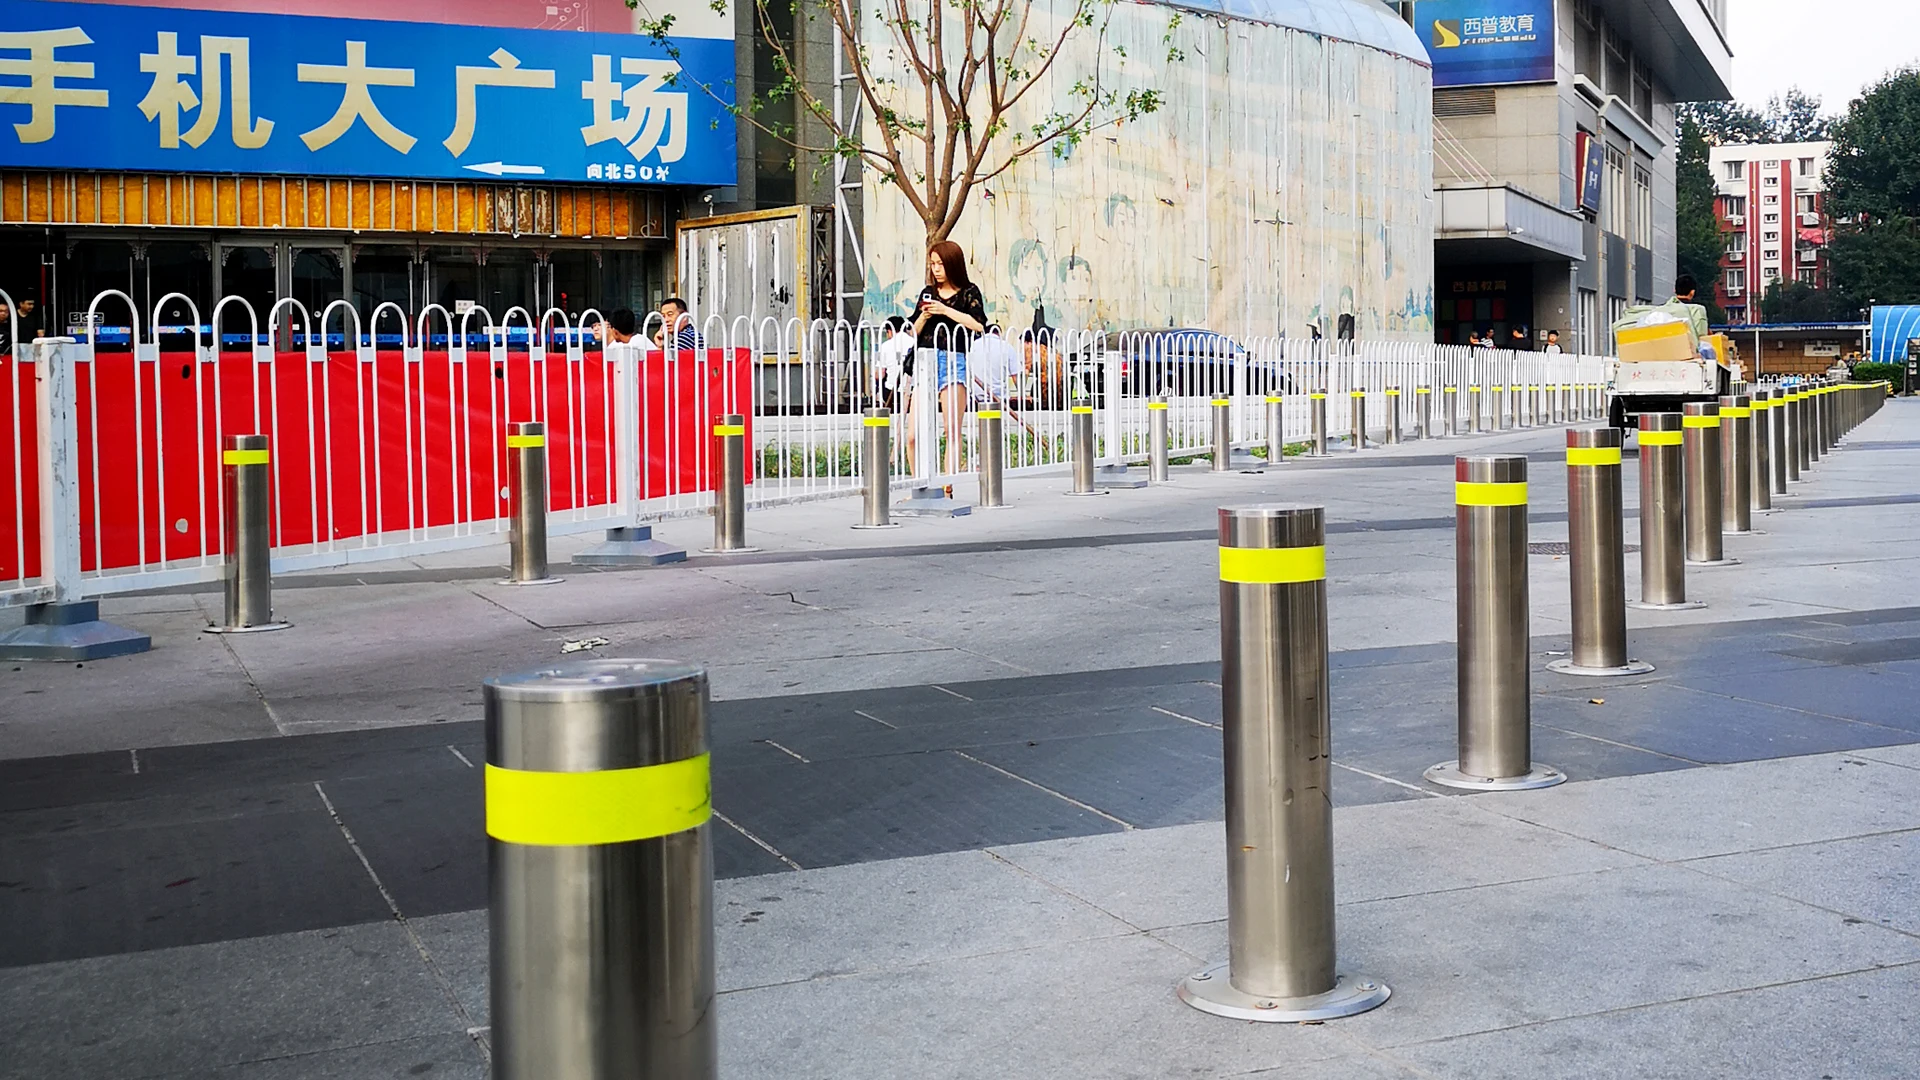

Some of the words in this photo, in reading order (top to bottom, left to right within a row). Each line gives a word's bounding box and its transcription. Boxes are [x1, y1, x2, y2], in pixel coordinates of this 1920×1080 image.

[1463, 14, 1535, 35] 西普教育
[0, 26, 689, 163] 手机大广场
